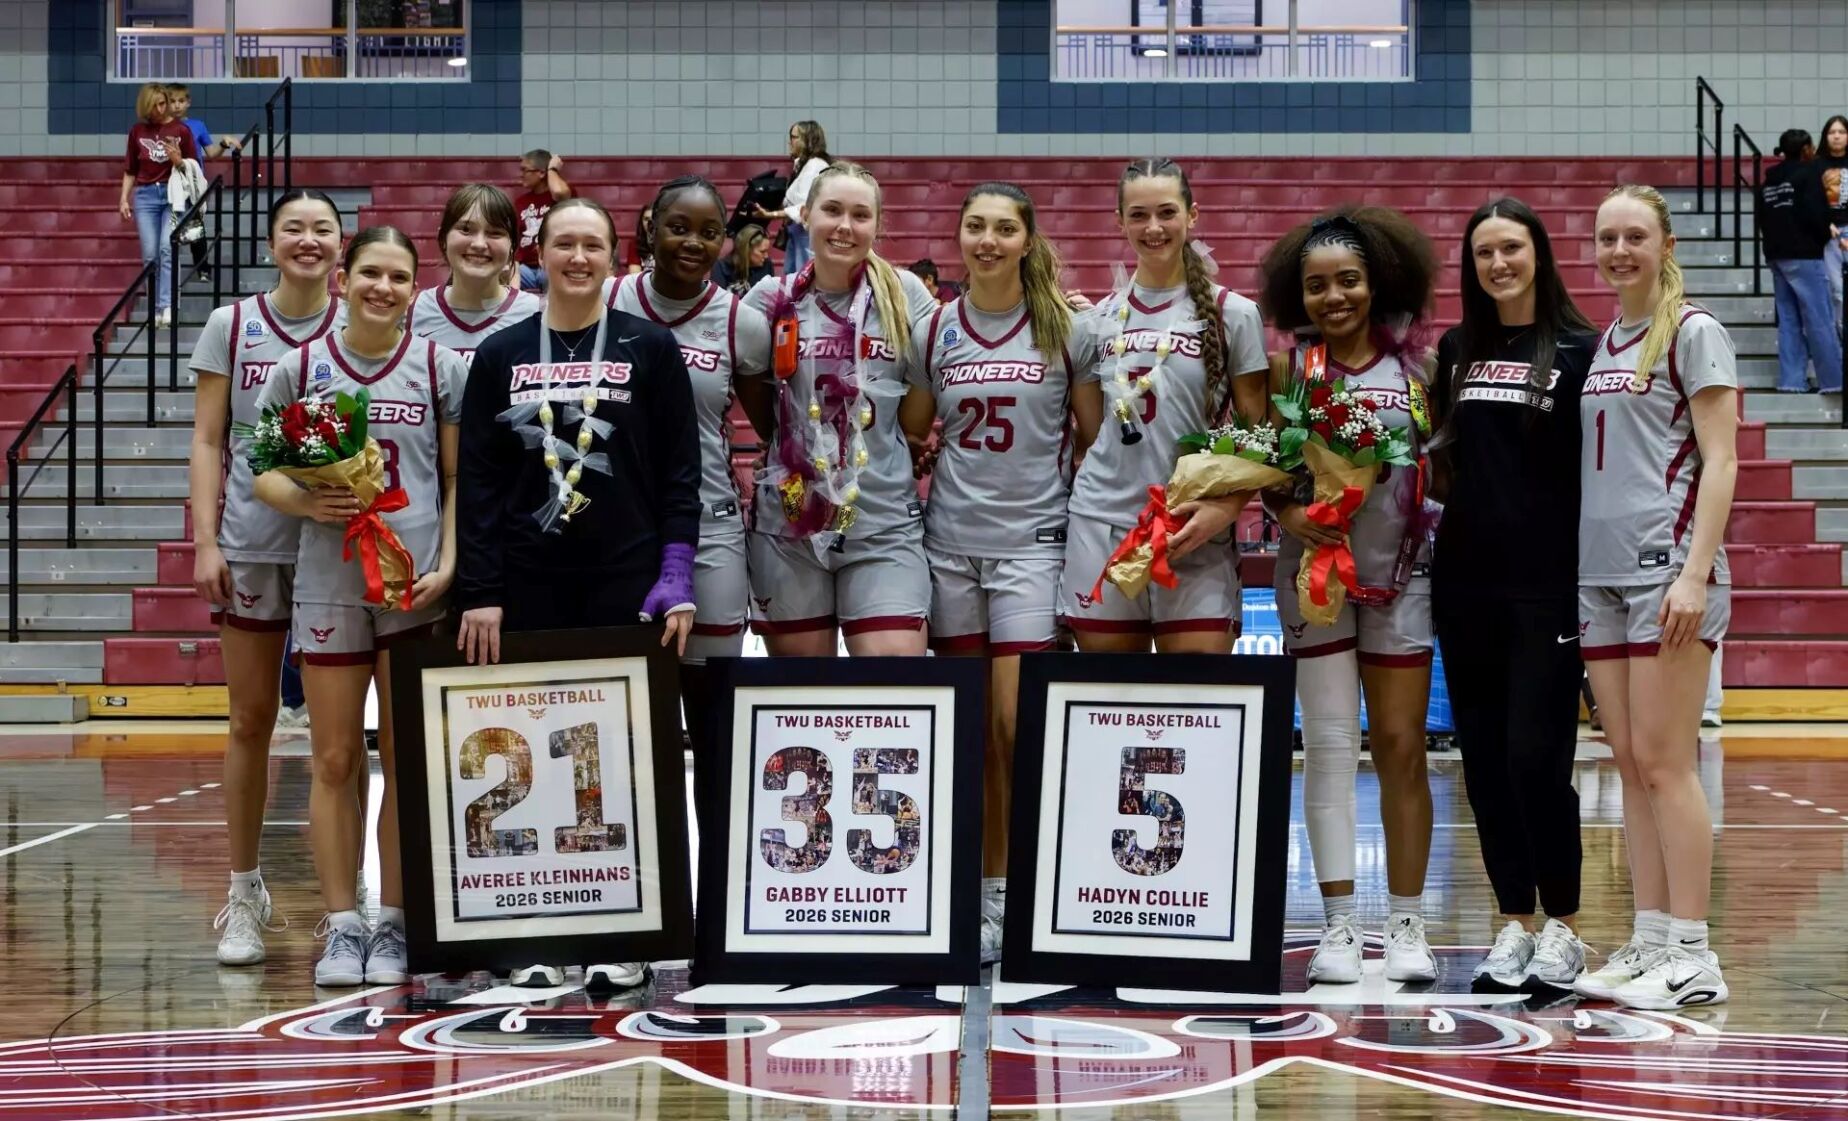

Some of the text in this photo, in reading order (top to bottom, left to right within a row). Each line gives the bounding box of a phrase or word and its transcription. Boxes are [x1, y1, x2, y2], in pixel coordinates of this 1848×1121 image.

[940, 361, 1047, 391] PIONEERS
[957, 396, 1017, 453] 25
[1596, 409, 1605, 471] 1
[466, 689, 606, 709] TWU BASKETBALL
[775, 715, 911, 729] TWU BASKETBALL
[1088, 713, 1221, 729] TWU BASKETBALL
[459, 721, 627, 858] 21
[760, 746, 921, 875] 35
[1111, 746, 1186, 877] 5
[460, 866, 631, 890] AVEREE KLEINHANS
[495, 889, 602, 908] 2026 SENIOR
[766, 887, 908, 904] GABBY ELLIOTT
[1078, 887, 1209, 908] HADYN COLLIE
[785, 908, 891, 923] 2026 SENIOR
[1092, 910, 1196, 927] 2026 SENIOR
